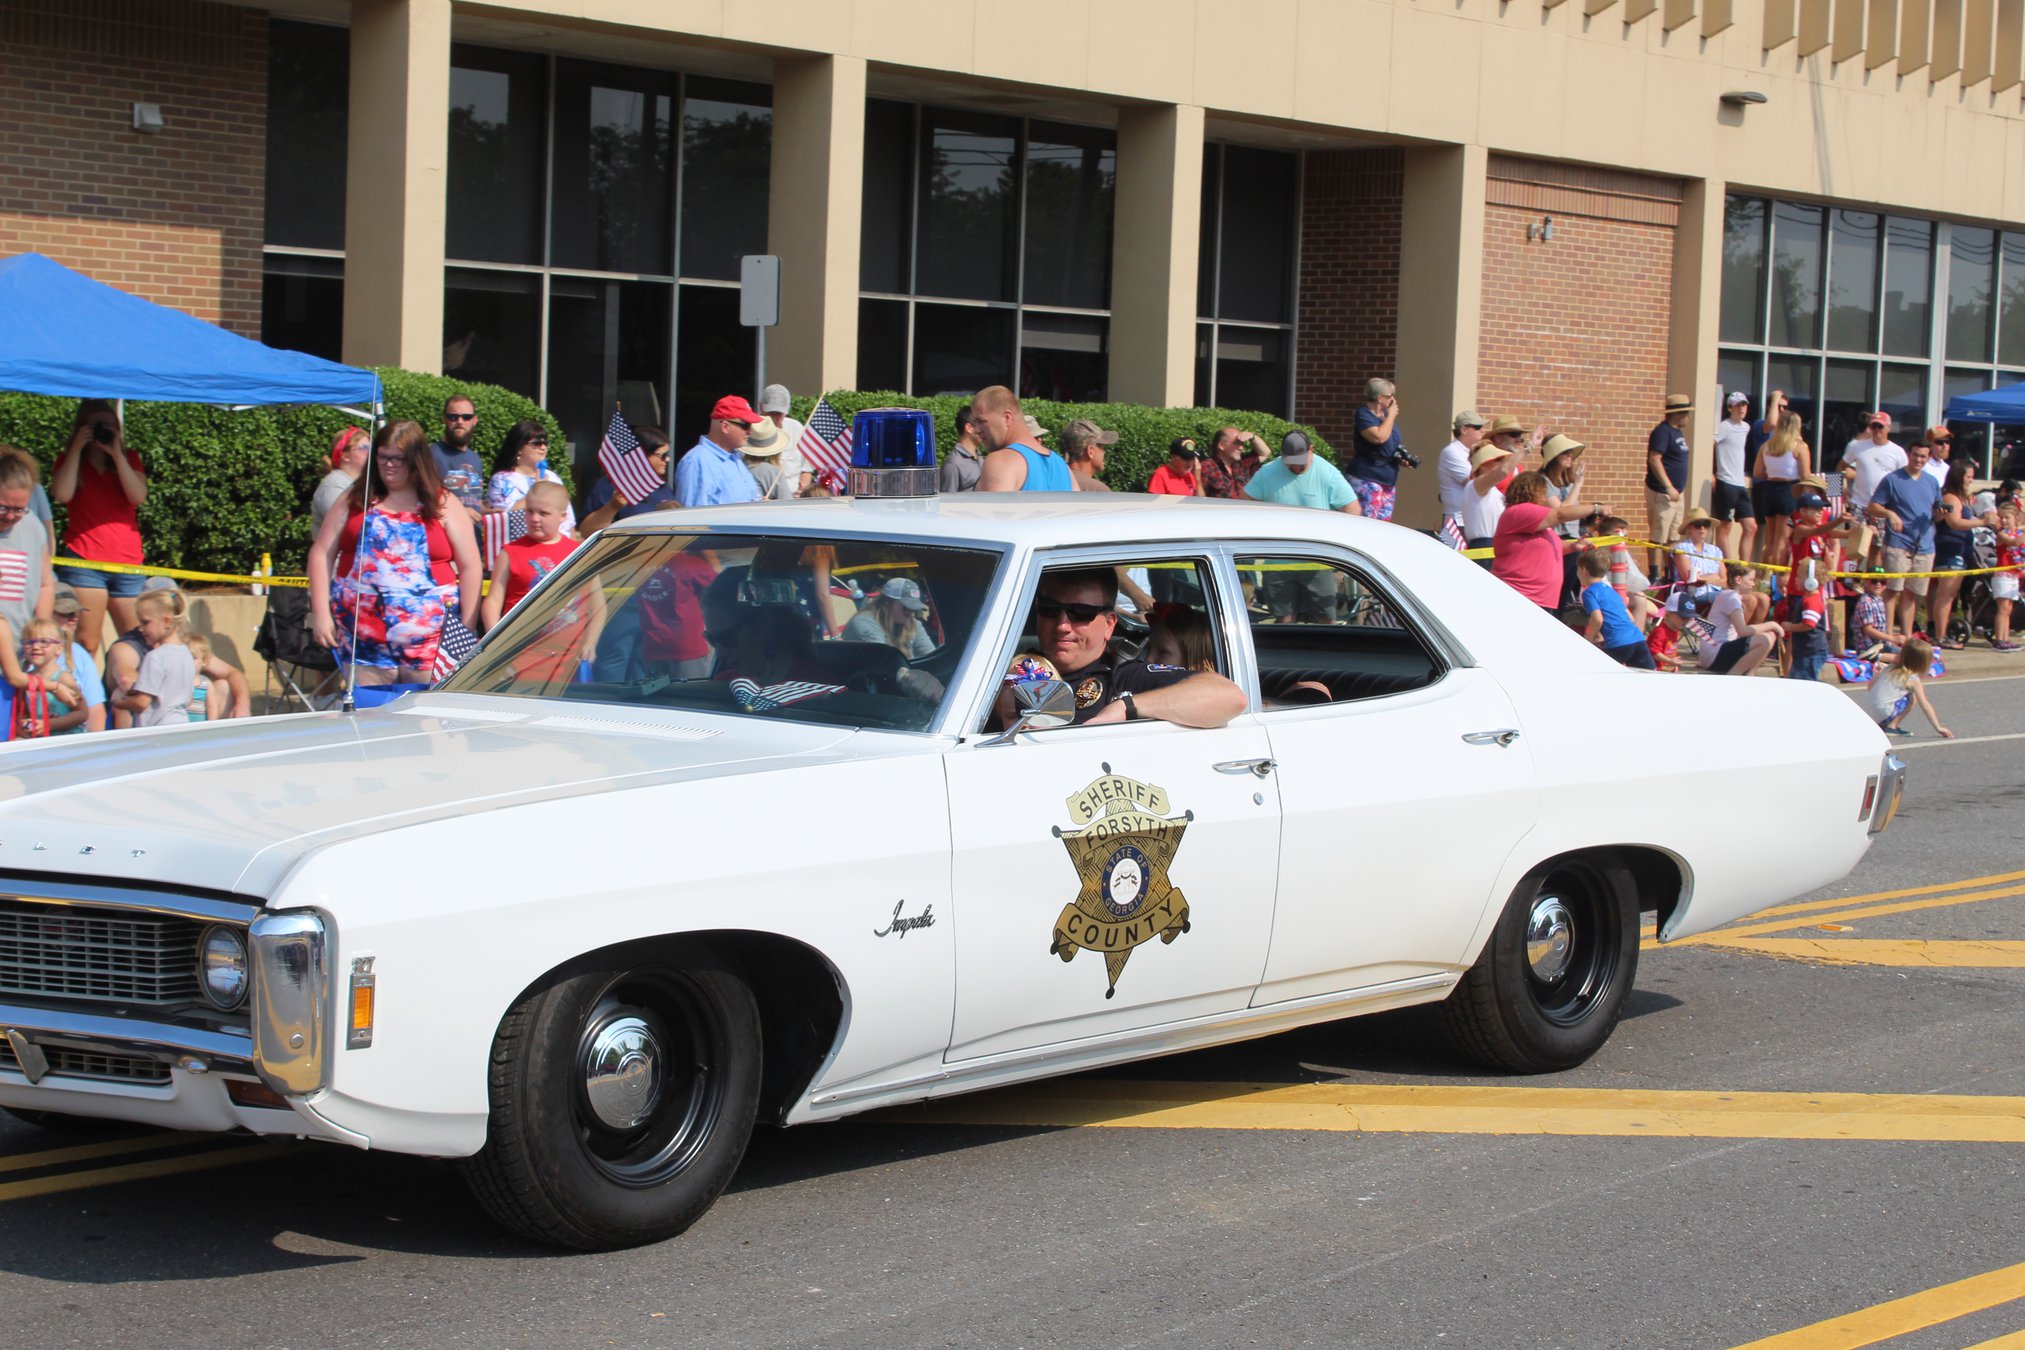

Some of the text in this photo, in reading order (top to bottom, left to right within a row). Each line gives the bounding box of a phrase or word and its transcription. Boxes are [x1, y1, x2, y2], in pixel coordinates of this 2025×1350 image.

[1079, 779, 1160, 819] SHERIFF
[1085, 816, 1168, 849] FORSYTH
[1106, 849, 1148, 873] STATE OF
[873, 899, 936, 940] Impala
[1105, 893, 1144, 915] GEORGIA
[1067, 897, 1174, 948] COUNTY
